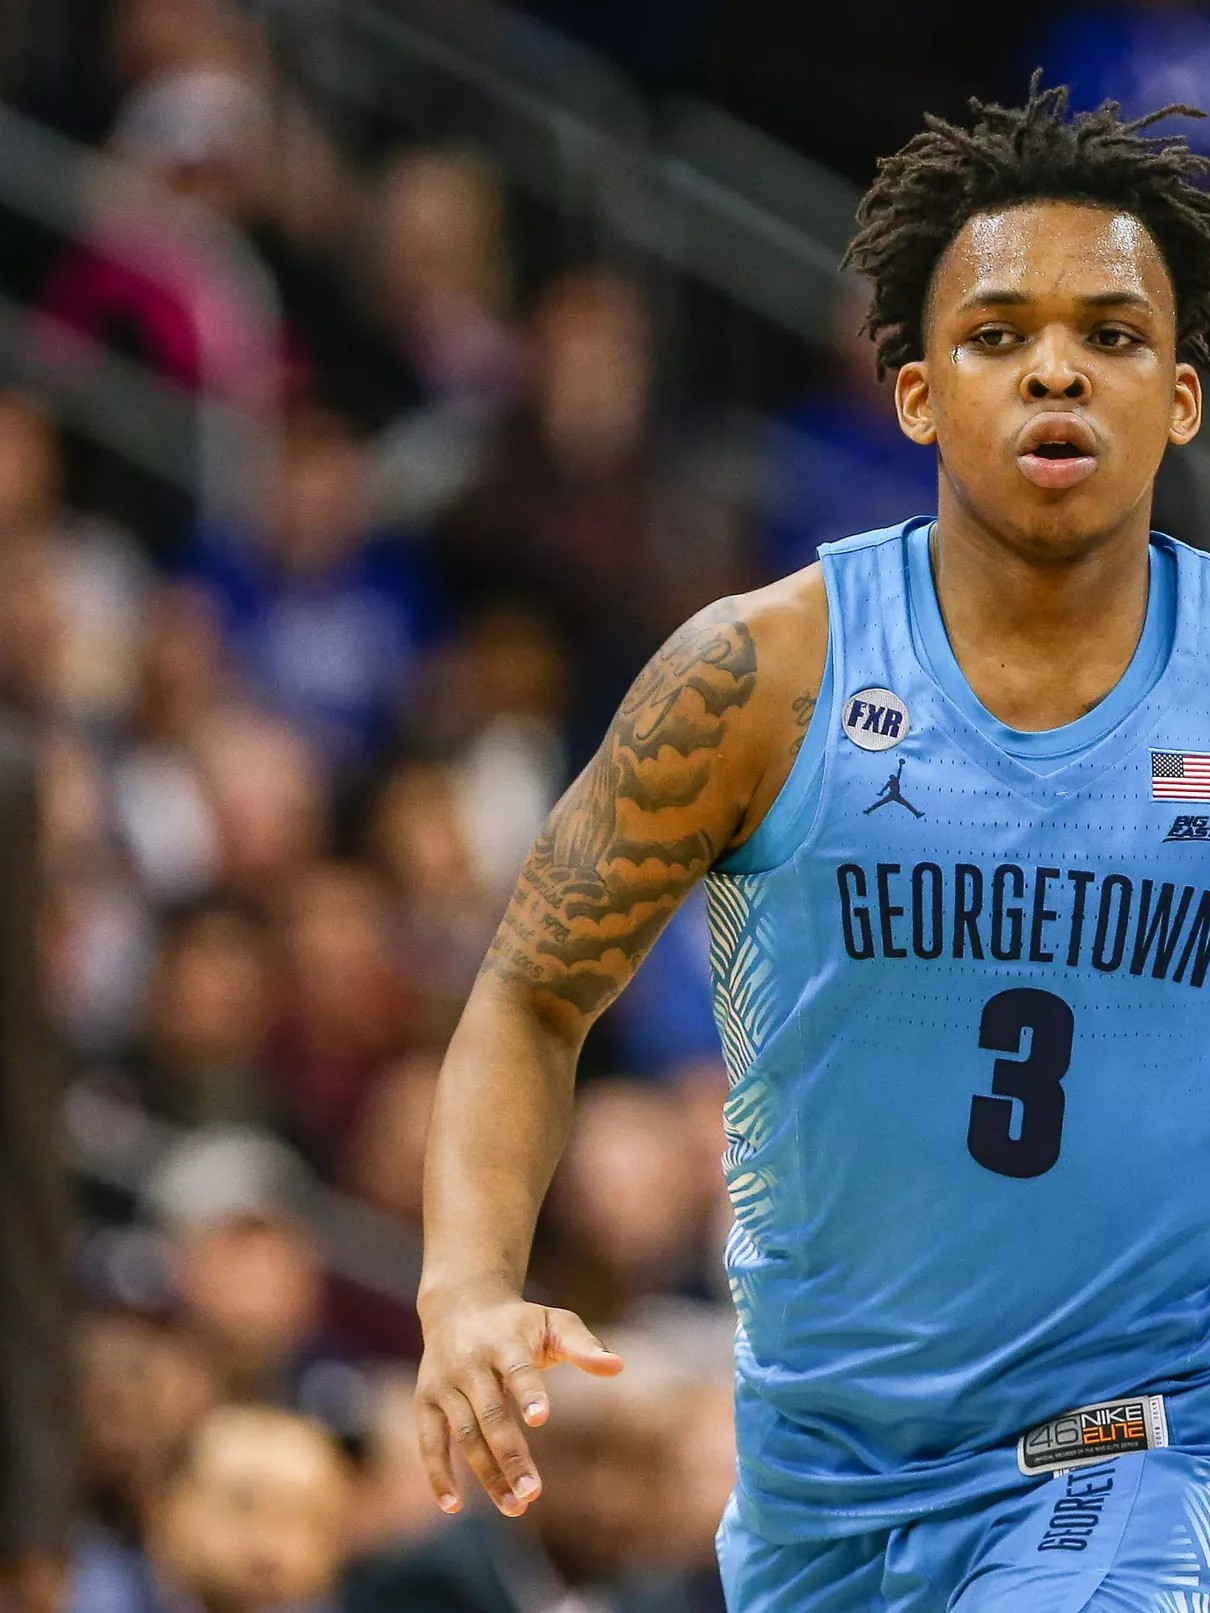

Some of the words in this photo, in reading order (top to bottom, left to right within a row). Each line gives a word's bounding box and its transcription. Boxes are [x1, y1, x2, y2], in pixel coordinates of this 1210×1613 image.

[847, 700, 903, 738] FXR
[1171, 815, 1209, 828] BIG
[967, 987, 1075, 1179] 3
[1081, 1404, 1143, 1428] NIKE
[1028, 1417, 1079, 1447] 46
[1083, 1421, 1145, 1445] ELITE
